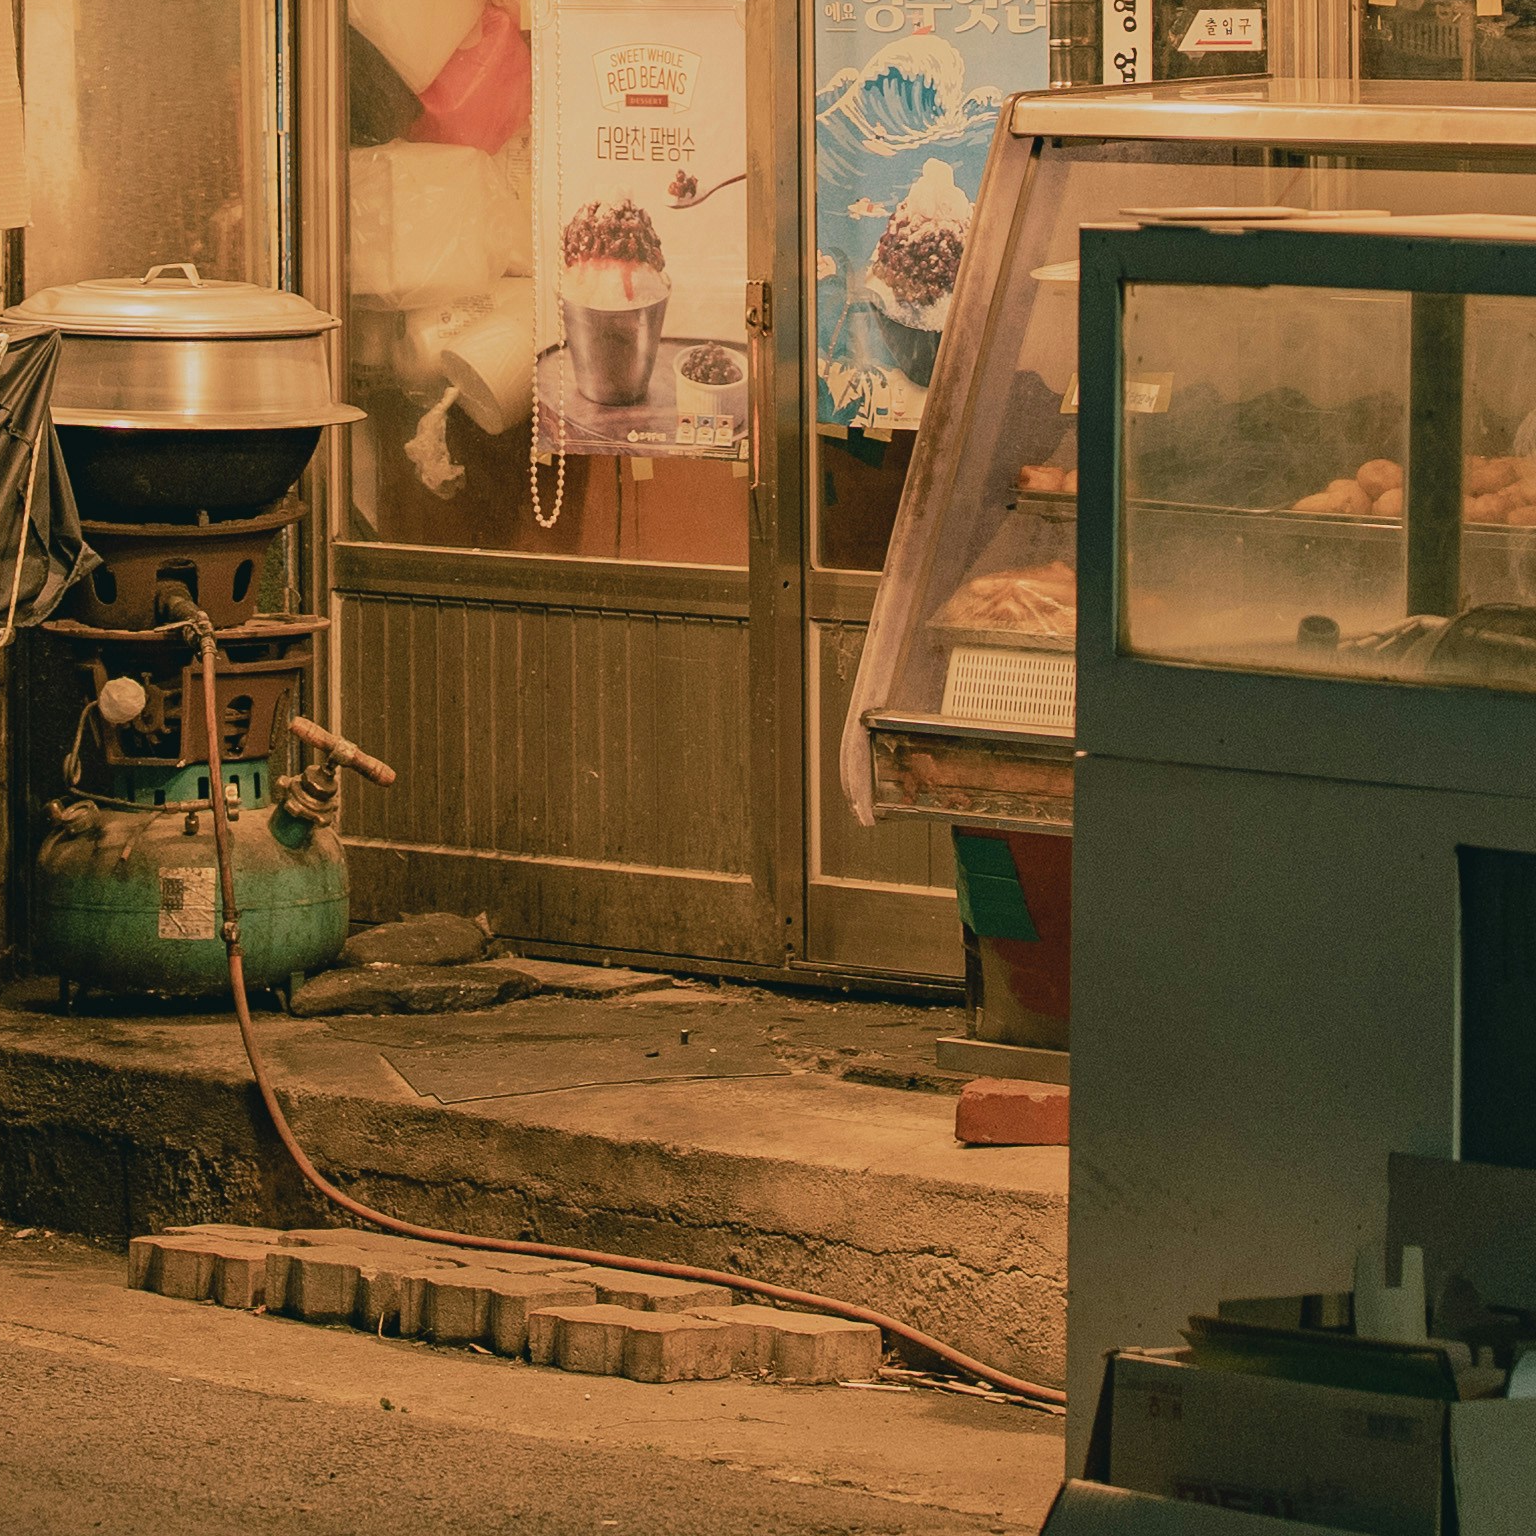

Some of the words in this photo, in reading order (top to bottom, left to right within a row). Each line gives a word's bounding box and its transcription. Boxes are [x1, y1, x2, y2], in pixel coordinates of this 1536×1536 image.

[824, 1, 857, 22] 에요
[1205, 17, 1252, 36] 출입구
[610, 47, 645, 68] SWEET
[647, 47, 684, 68] WHOLE
[607, 67, 637, 95] RED
[640, 65, 687, 95] BEANS
[597, 126, 646, 161] 더알찬
[650, 127, 695, 162] 팥빙수
